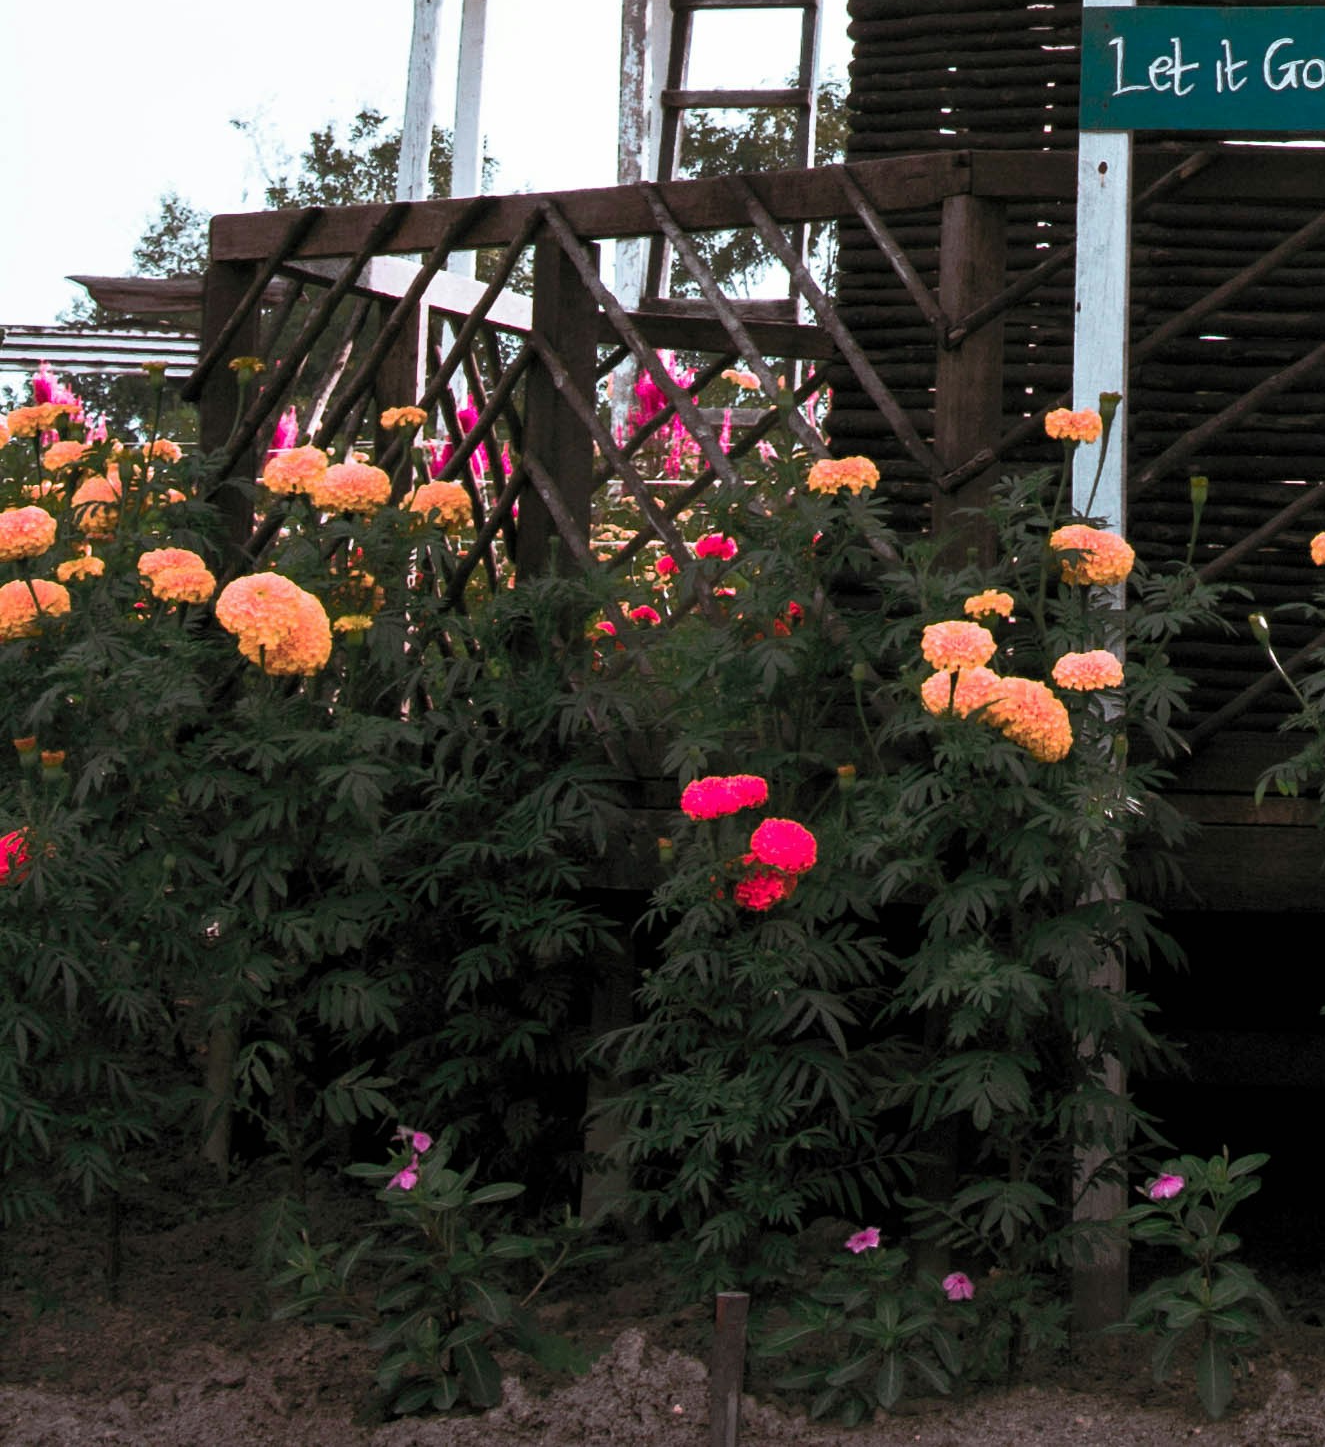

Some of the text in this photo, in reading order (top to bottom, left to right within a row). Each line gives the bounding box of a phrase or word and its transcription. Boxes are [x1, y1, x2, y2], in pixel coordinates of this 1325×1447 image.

[1109, 37, 1325, 96] Let it Go
